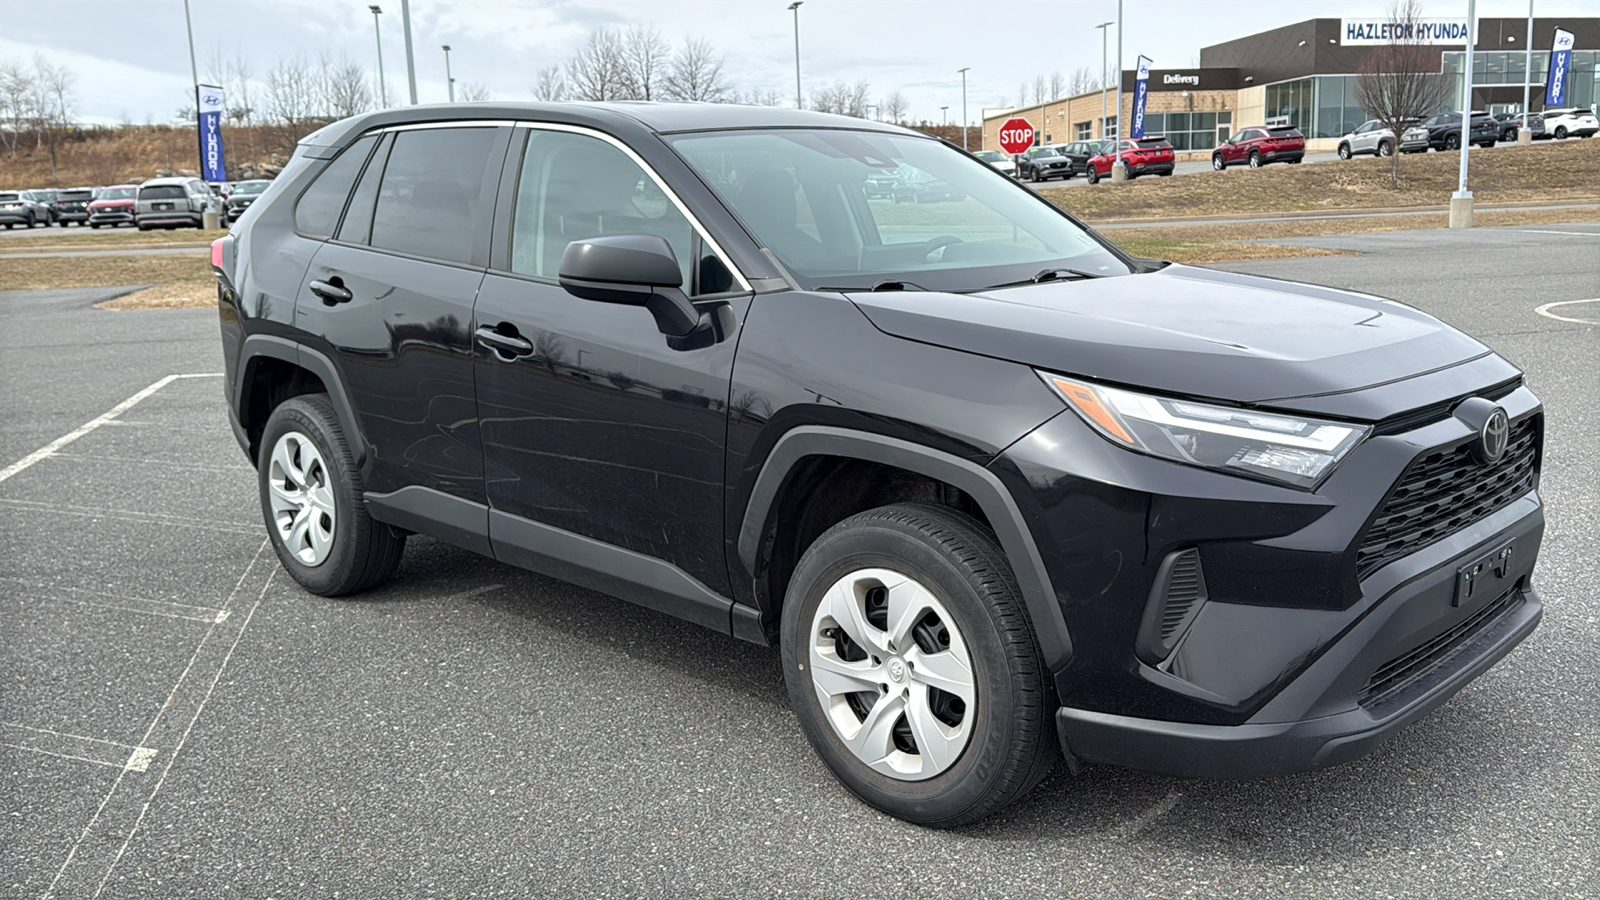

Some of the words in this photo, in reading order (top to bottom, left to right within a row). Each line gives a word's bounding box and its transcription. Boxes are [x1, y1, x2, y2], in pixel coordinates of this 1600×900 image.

[1347, 23, 1415, 40] HAZLETON
[1417, 23, 1468, 39] HYUNDA
[1163, 74, 1199, 86] Delivery
[1552, 53, 1566, 104] HYUNDAI
[1001, 129, 1032, 144] STOP
[207, 114, 218, 179] HYUNDAI
